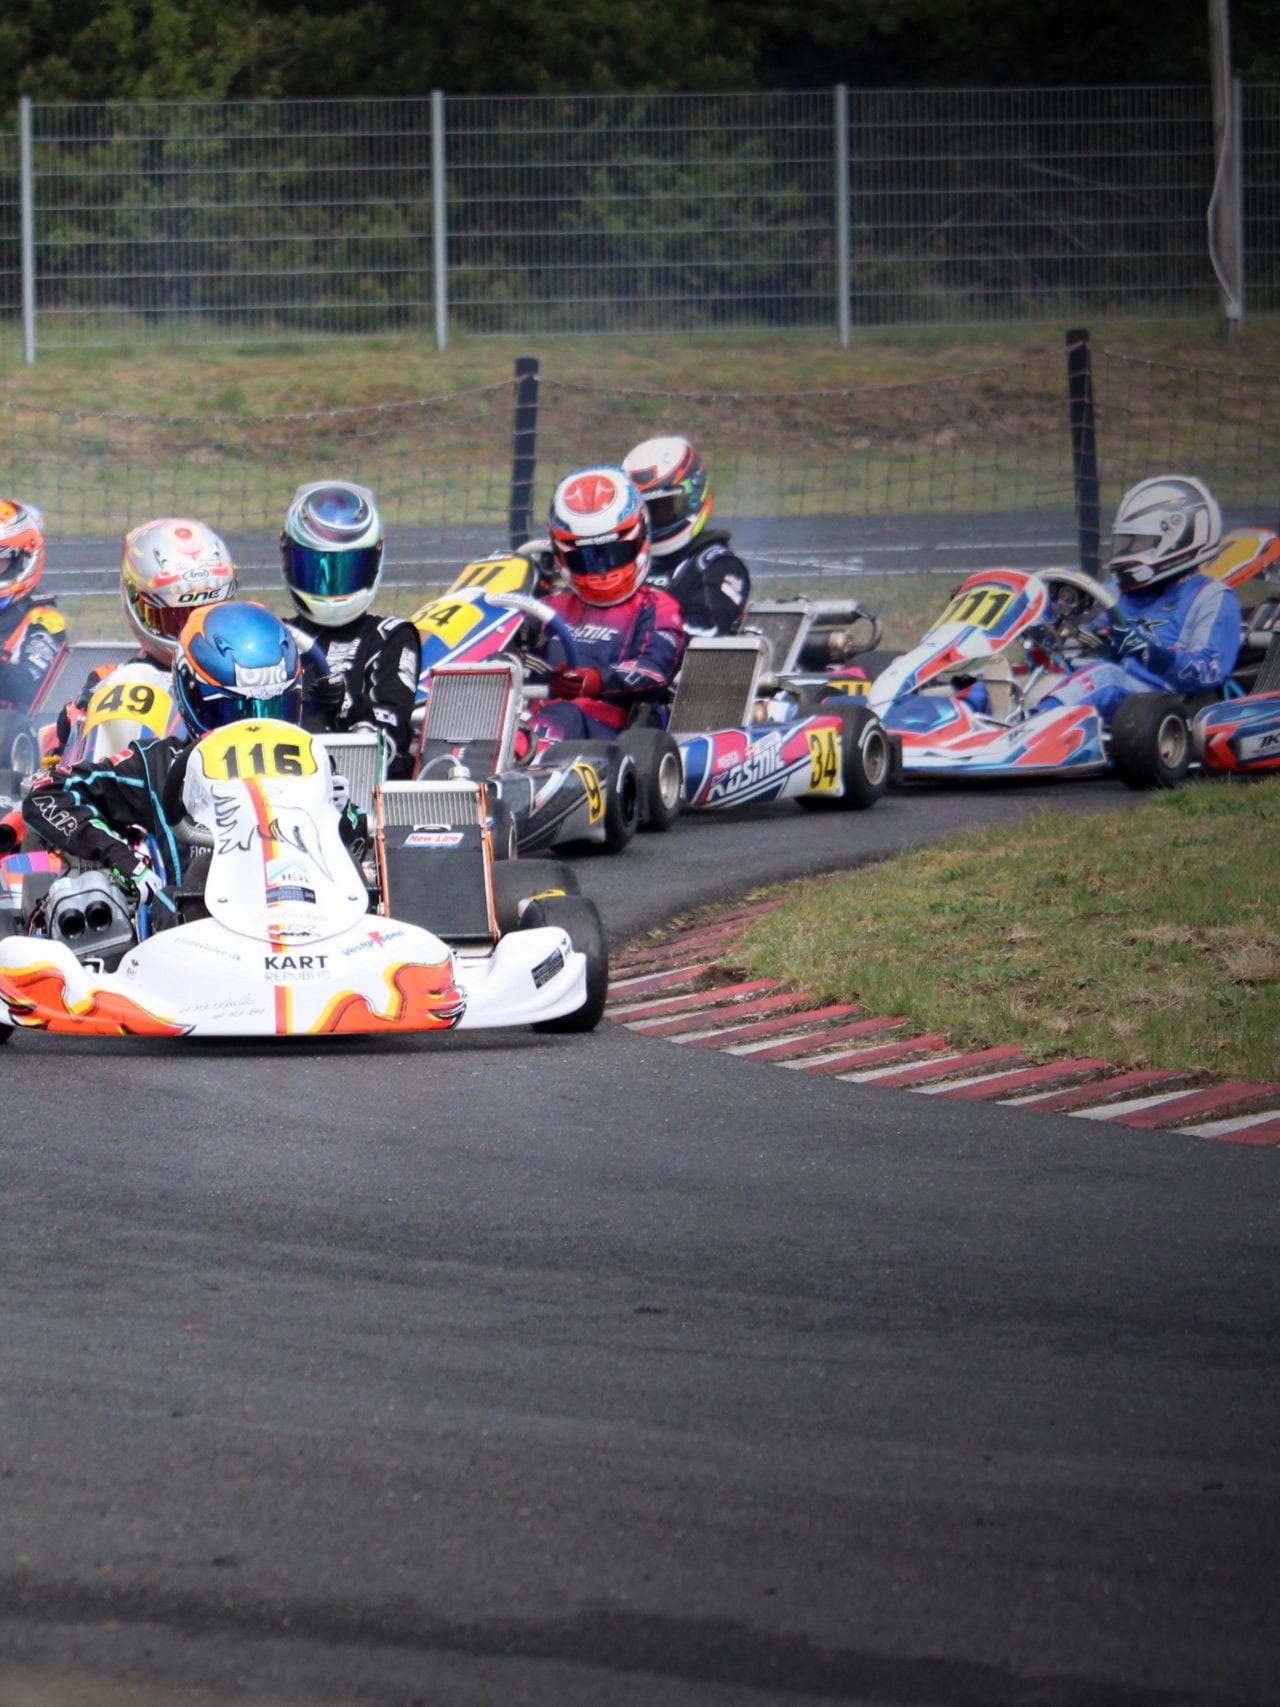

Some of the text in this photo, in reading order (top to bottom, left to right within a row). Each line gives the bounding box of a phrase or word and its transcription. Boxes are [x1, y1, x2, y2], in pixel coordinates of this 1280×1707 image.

[943, 590, 1011, 625] 111
[96, 684, 155, 715] 49
[221, 743, 303, 780] 116
[706, 742, 786, 801] KOSMIC
[810, 731, 837, 789] 34
[581, 766, 601, 819] 9
[264, 955, 328, 970] KART
[265, 970, 331, 982] REPUBLIC
